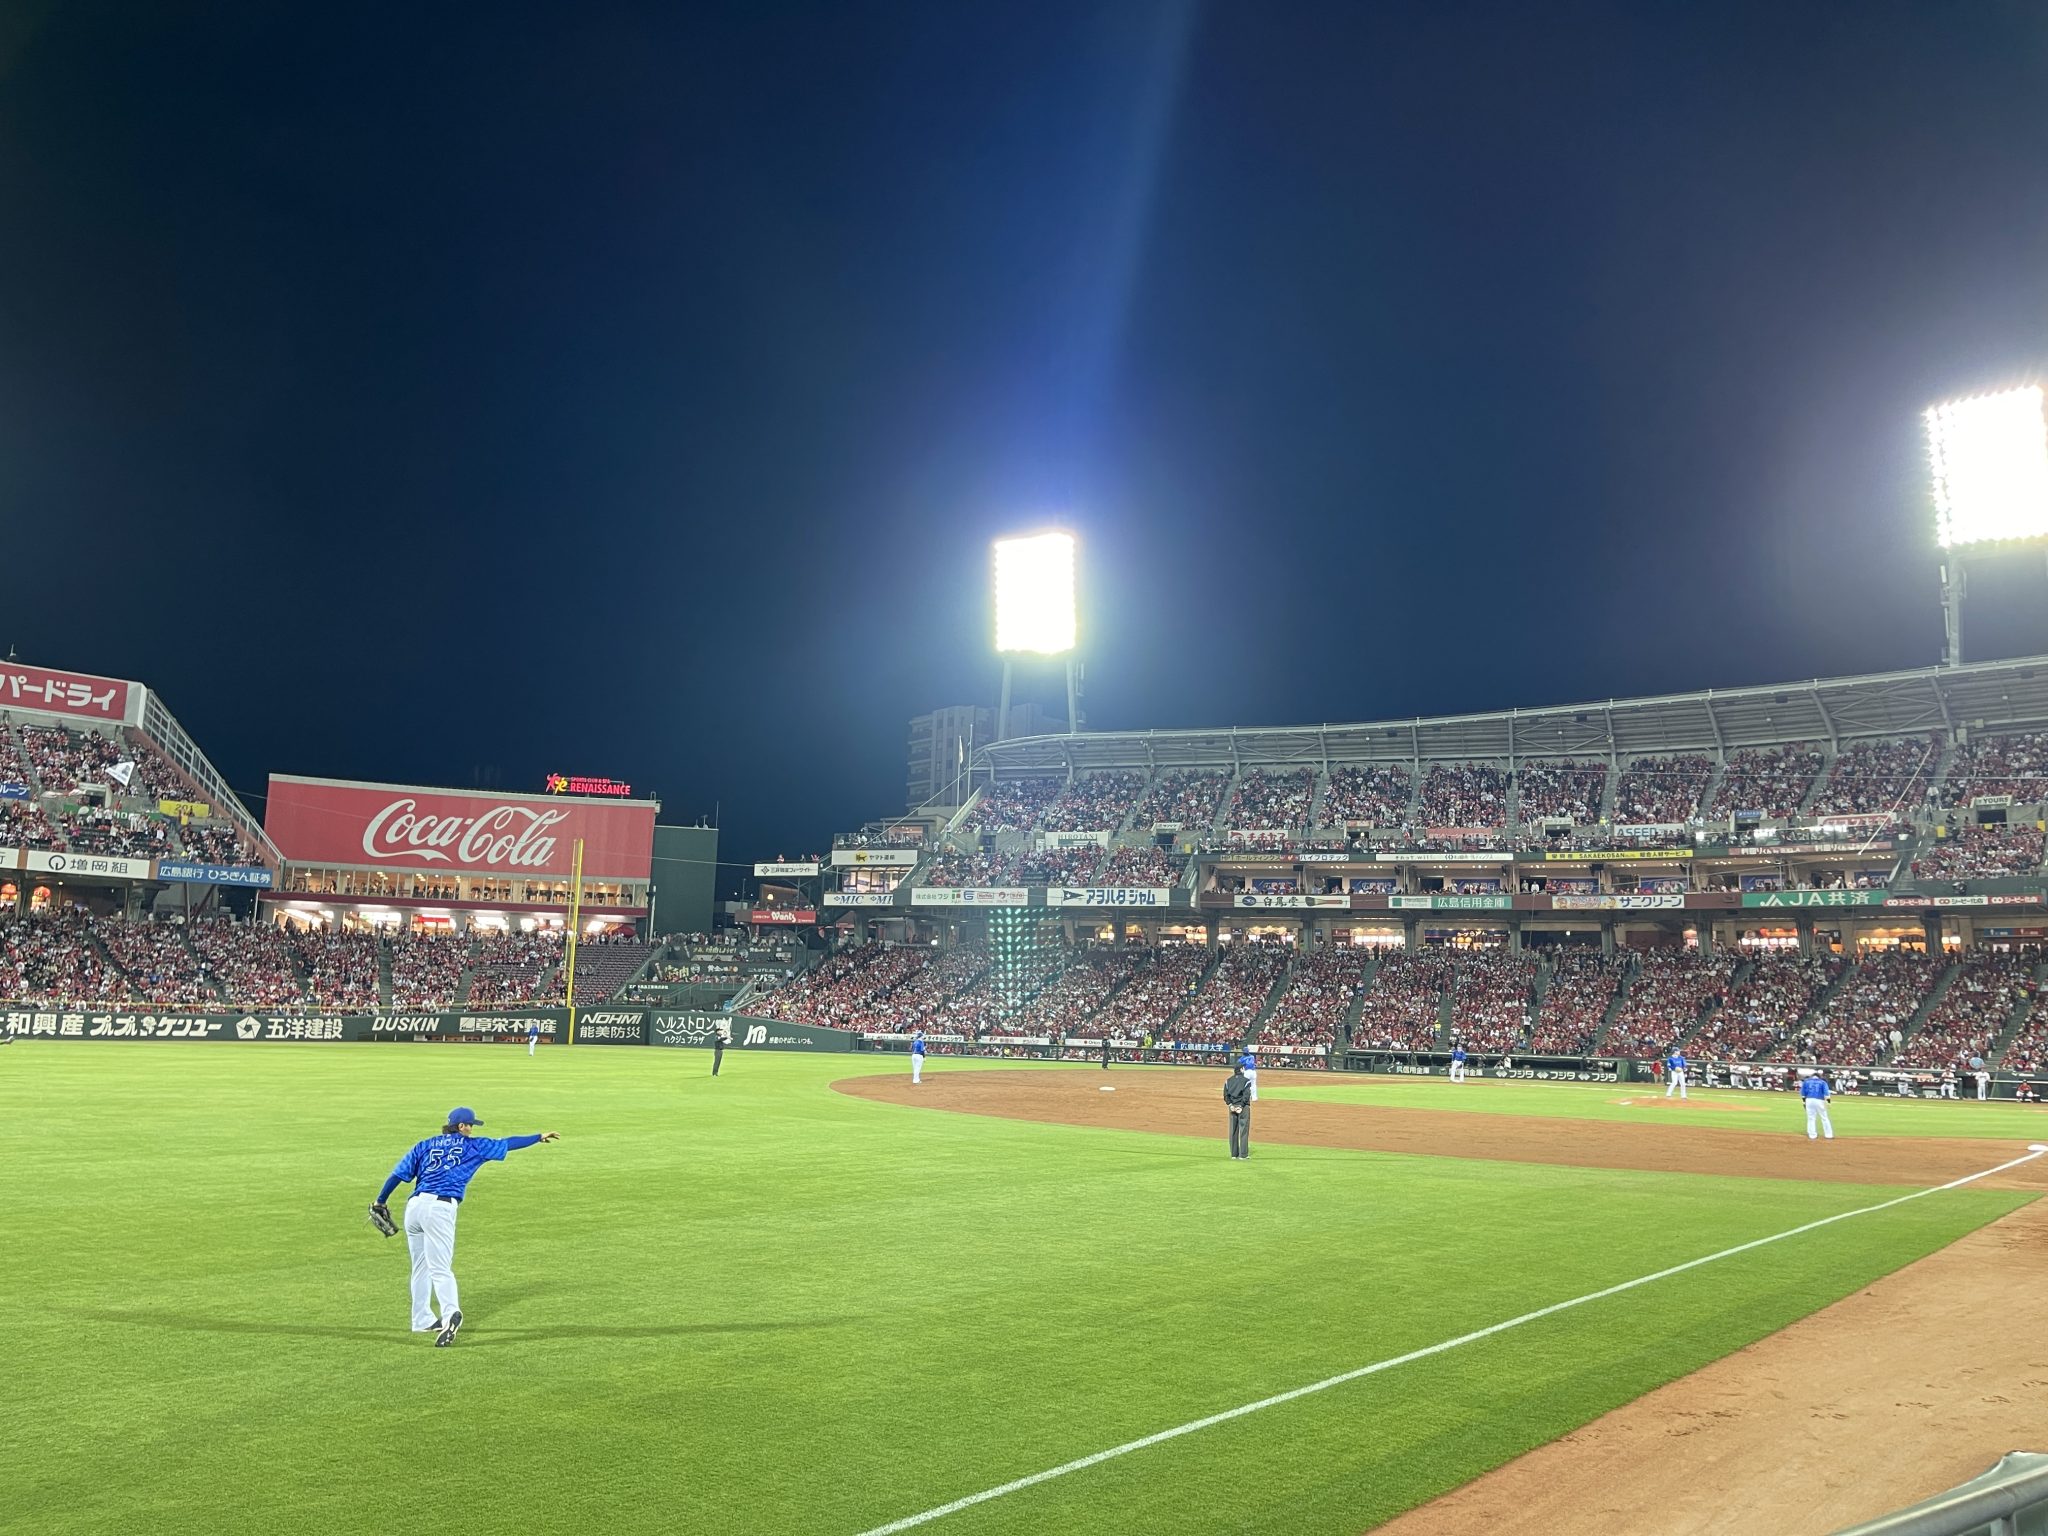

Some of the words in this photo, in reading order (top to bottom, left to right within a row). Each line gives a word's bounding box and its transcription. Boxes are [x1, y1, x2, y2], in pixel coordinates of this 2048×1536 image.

[0, 674, 116, 711] パードライ
[570, 783, 631, 795] RENAISSANCE
[363, 799, 570, 866] Coca-Cola
[70, 859, 128, 874] 増岡組
[840, 895, 864, 904] MIC
[875, 895, 893, 904] MI
[1437, 897, 1505, 908] 広島信用金庫
[1621, 896, 1682, 907] サニクリーン
[0, 1013, 84, 1036] 和興産
[372, 1017, 440, 1032] DUSKIN
[580, 1012, 644, 1024] NOHMI
[156, 1016, 222, 1037] ケンユー
[265, 1018, 343, 1040] 五洋建設
[580, 1026, 640, 1039] 能美防災
[743, 1025, 767, 1046] JTB
[1509, 1070, 1534, 1079] フジタ
[1550, 1071, 1575, 1081] フジタ
[1592, 1073, 1617, 1082] フジタ
[426, 1146, 463, 1172] 55
